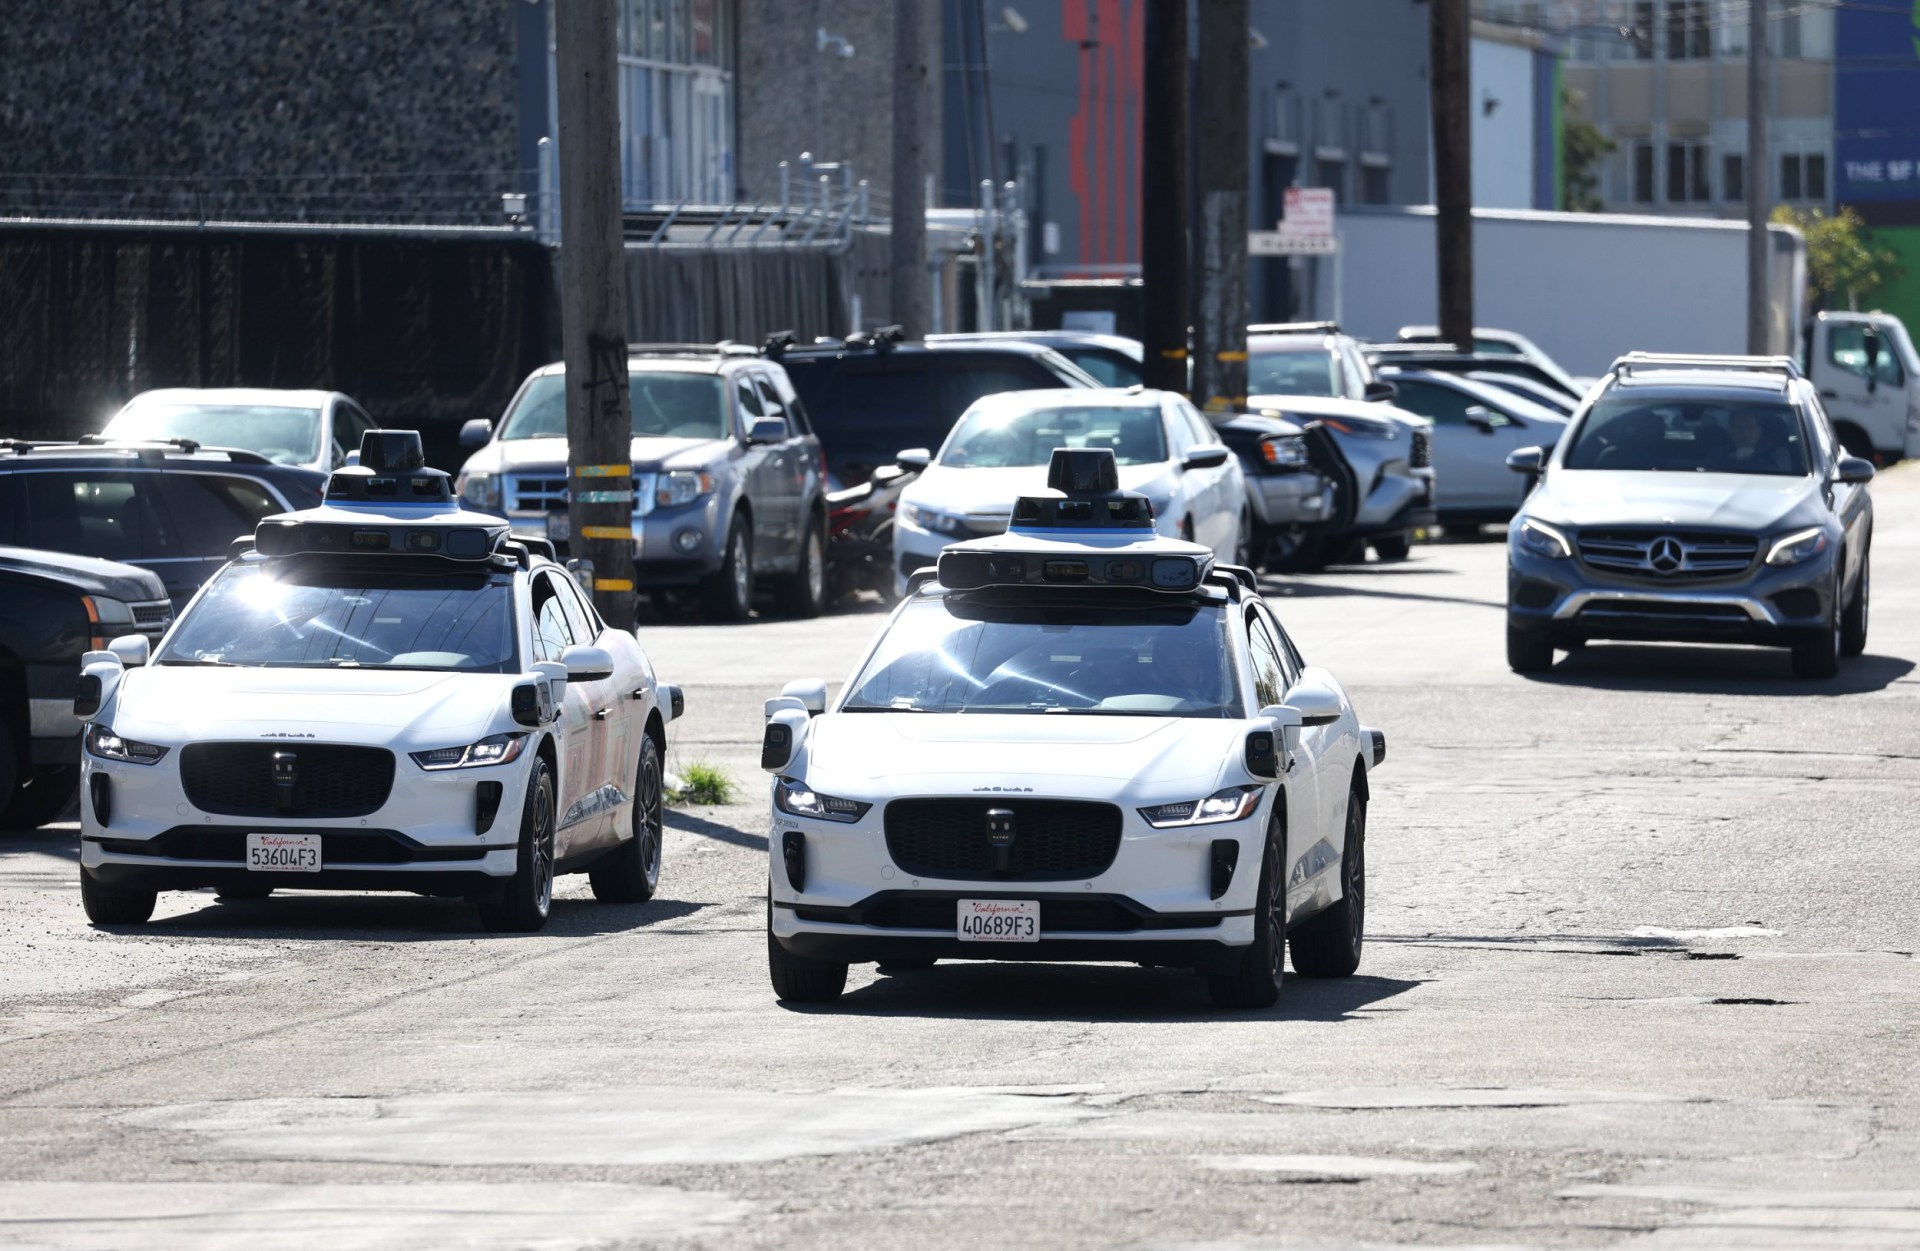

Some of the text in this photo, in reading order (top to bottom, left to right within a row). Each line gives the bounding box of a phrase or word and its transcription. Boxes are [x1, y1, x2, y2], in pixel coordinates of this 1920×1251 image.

[262, 836, 305, 848] California
[252, 848, 316, 866] 53604F3
[974, 902, 1022, 916] California
[963, 915, 1034, 936] 40689F3
